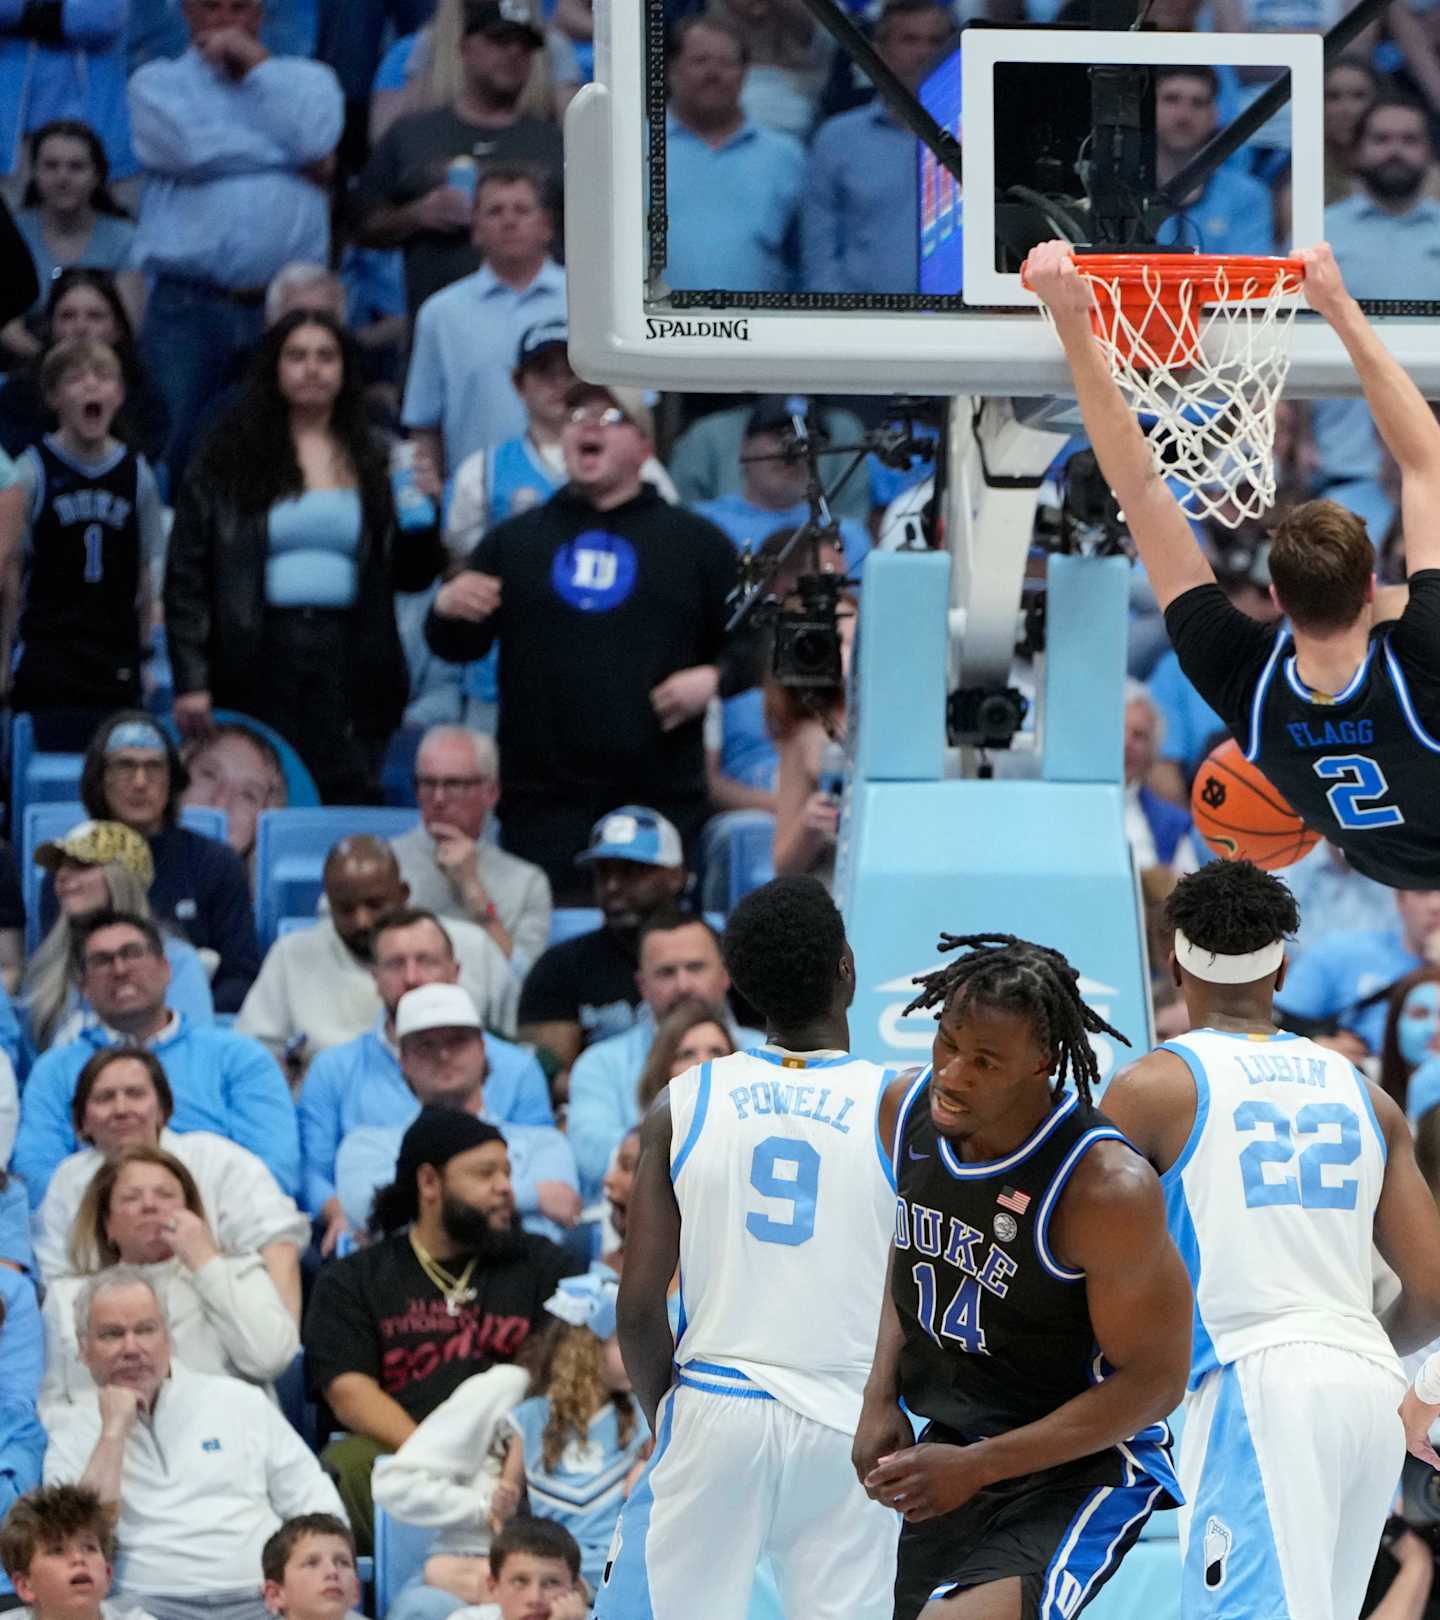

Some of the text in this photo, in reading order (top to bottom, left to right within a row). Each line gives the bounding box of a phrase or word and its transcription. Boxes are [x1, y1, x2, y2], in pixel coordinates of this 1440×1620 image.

[646, 318, 748, 341] SPALDING
[84, 522, 104, 583] 1
[1285, 719, 1374, 749] FLAGG
[1312, 754, 1405, 829] 2
[1233, 1054, 1328, 1088] LUBIN
[729, 1081, 855, 1134] POWELL
[1232, 1101, 1362, 1211] 22
[745, 1136, 821, 1246] 9
[895, 1196, 1018, 1299] DUKE
[912, 1261, 992, 1356] 14
